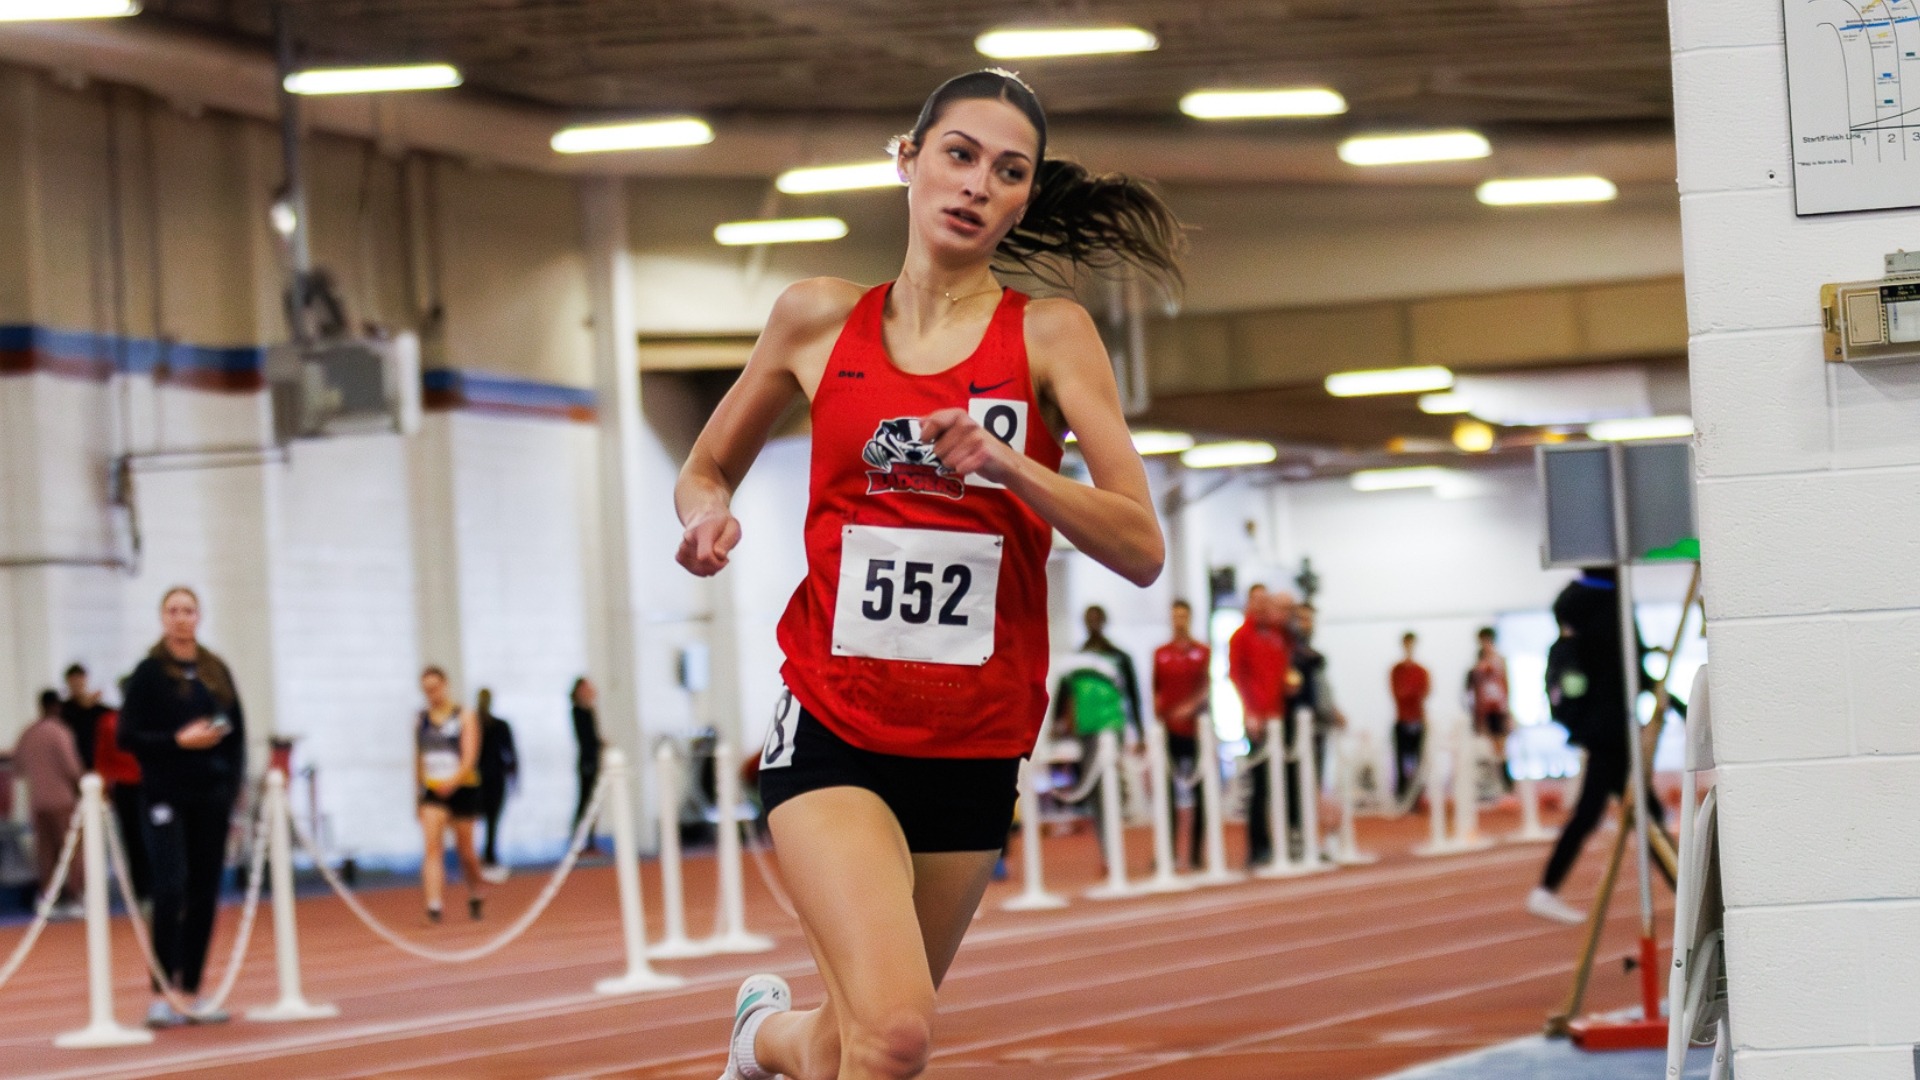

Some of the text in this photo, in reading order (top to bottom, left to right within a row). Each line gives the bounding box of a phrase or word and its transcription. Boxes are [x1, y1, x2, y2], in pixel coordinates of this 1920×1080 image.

[1887, 133, 1896, 144] 2
[1912, 131, 1920, 142] 3
[861, 558, 972, 626] 552
[765, 688, 793, 765] 8
